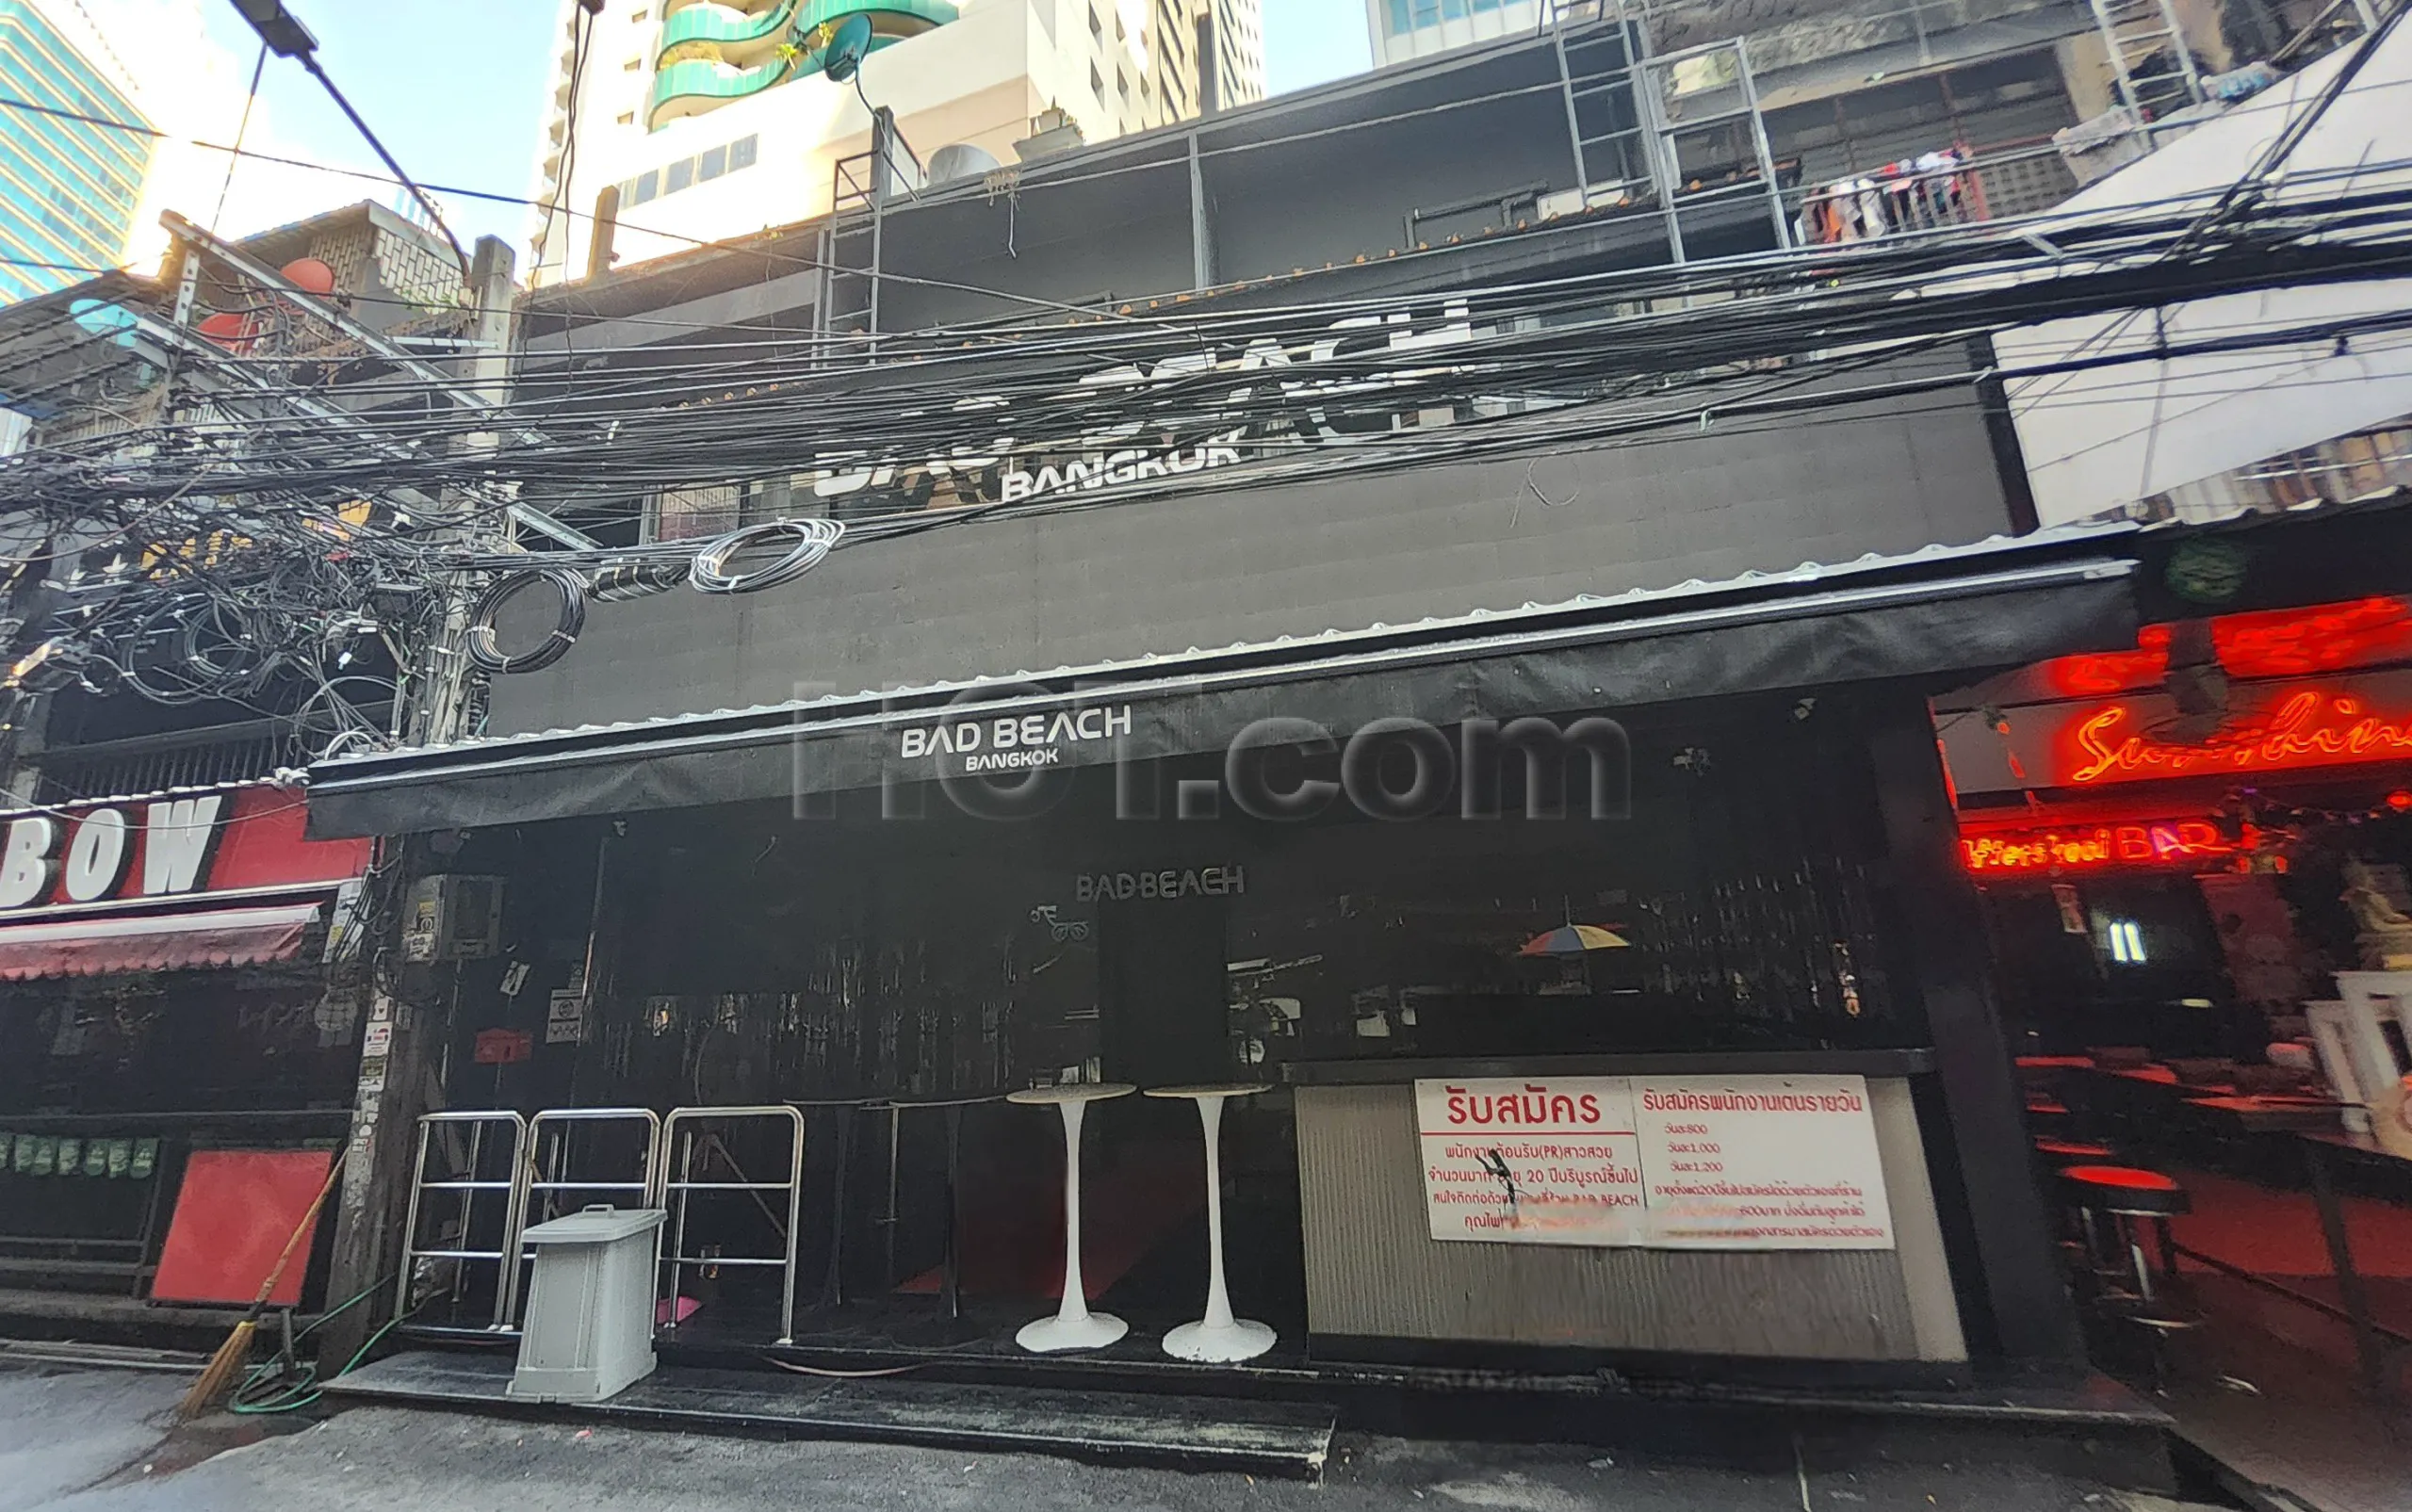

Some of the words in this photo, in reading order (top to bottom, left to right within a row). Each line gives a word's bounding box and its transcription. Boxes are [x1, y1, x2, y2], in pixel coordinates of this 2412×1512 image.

[902, 725, 982, 758] BAD
[993, 705, 1132, 749] BEACH
[966, 747, 1059, 772] BANGKOK
[1443, 1083, 1602, 1125] รับสมัคร
[1527, 1169, 1545, 1184] 20
